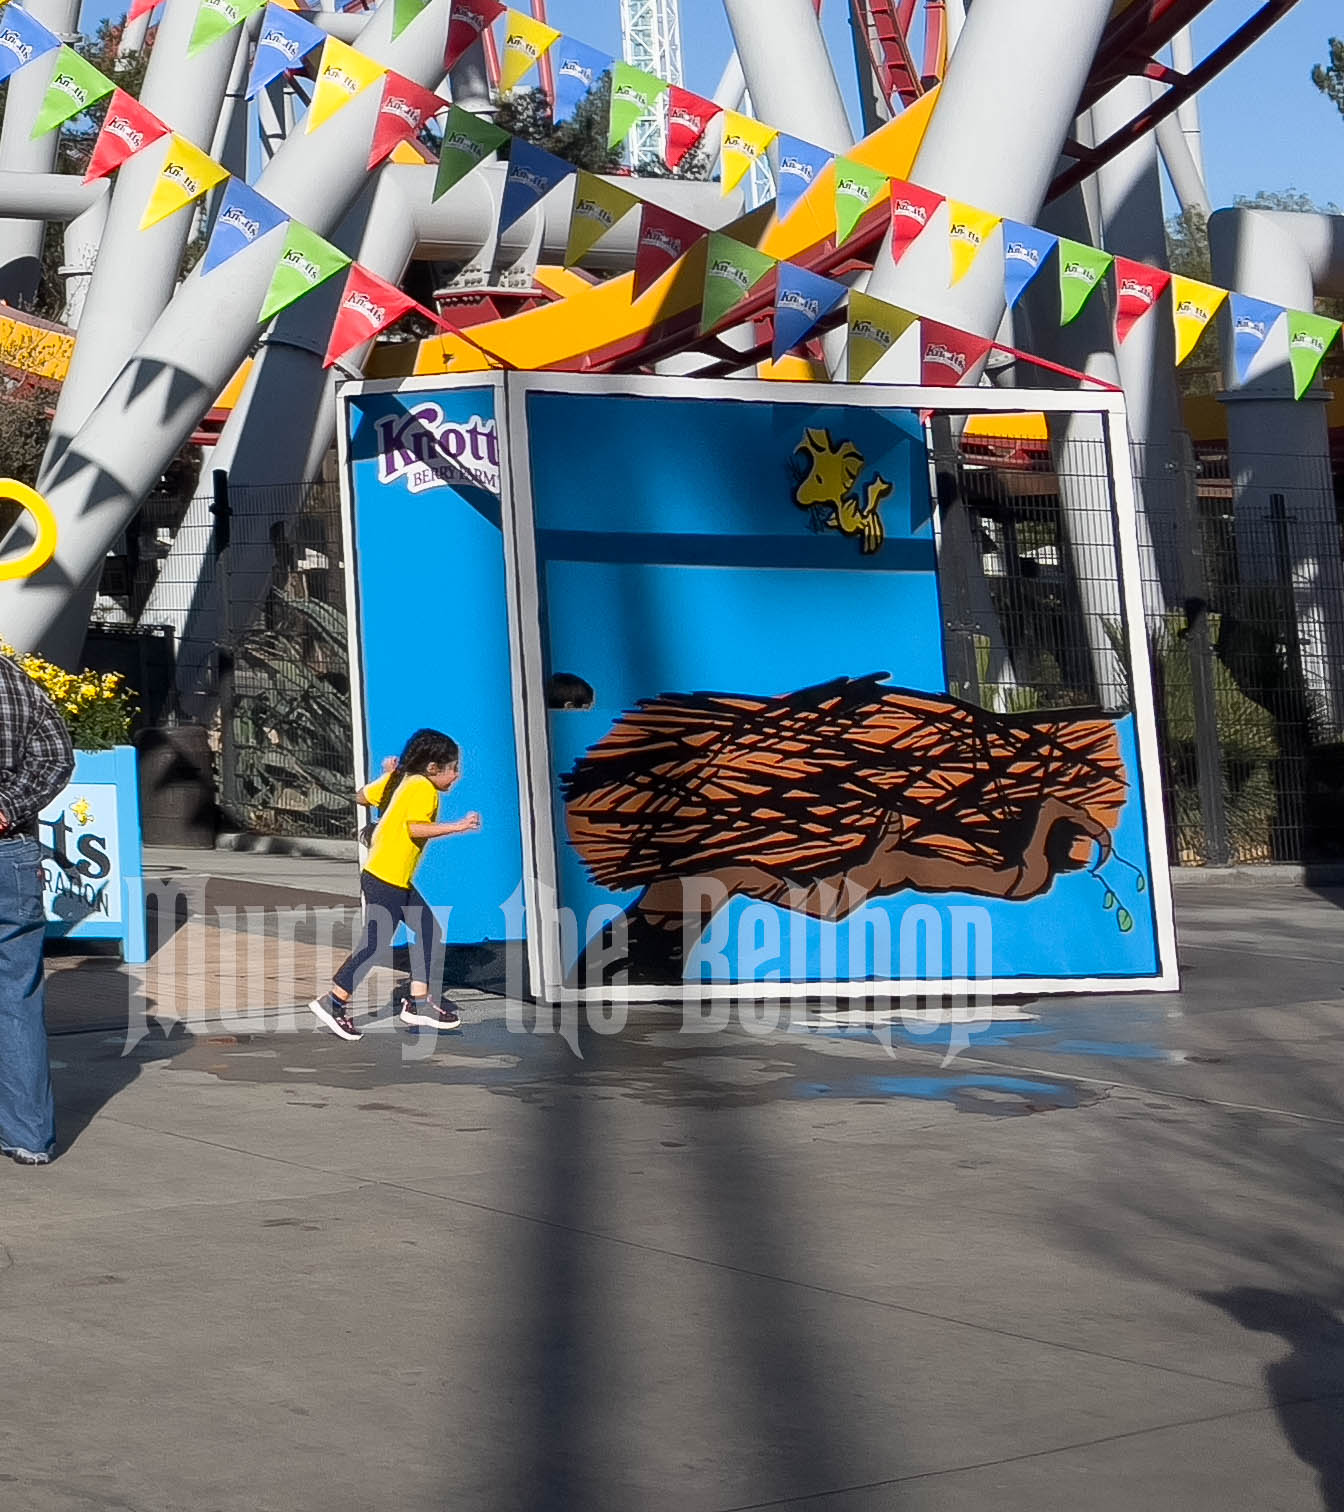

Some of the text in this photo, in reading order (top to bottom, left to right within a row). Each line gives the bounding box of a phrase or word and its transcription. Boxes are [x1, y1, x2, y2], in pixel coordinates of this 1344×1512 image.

[454, 6, 482, 29] Kntt's
[1, 29, 29, 59] Kntt's
[264, 30, 297, 57] Kntt's
[507, 35, 536, 56] Kntt's
[324, 66, 356, 92] Kntt's
[561, 60, 592, 82] Kntt's
[55, 74, 86, 103] Kntt's
[616, 85, 645, 106] Kntt's
[386, 97, 418, 125] Kntt's
[671, 108, 700, 130] Kntt's
[109, 117, 141, 147] Kntt's
[448, 132, 481, 156] Kntt's
[725, 136, 755, 156] Kntt's
[164, 163, 196, 193] Kntt's
[513, 166, 547, 190] Kntt's
[781, 157, 812, 179] Kntt's
[838, 179, 869, 200] Kntt's
[224, 207, 258, 236] Kntt's
[577, 199, 611, 224] Kntt's
[895, 201, 925, 221] Kntt's
[646, 229, 681, 254] Kntt's
[951, 225, 980, 244] Kntt's
[284, 249, 317, 278] Kntt's
[1008, 245, 1037, 264] Kntt's
[712, 260, 749, 285] Kntt's
[1065, 263, 1095, 281] Kntt's
[781, 290, 817, 314] Kntt's
[1122, 280, 1152, 302] Kntt's
[349, 293, 383, 322] Kntt's
[1177, 302, 1207, 319] Kntt's
[851, 320, 890, 344] Kntt's
[1236, 318, 1264, 336] Kntt's
[1292, 333, 1323, 351] Kntt's
[927, 344, 966, 367] Kntt's
[413, 469, 458, 487] BERRY
